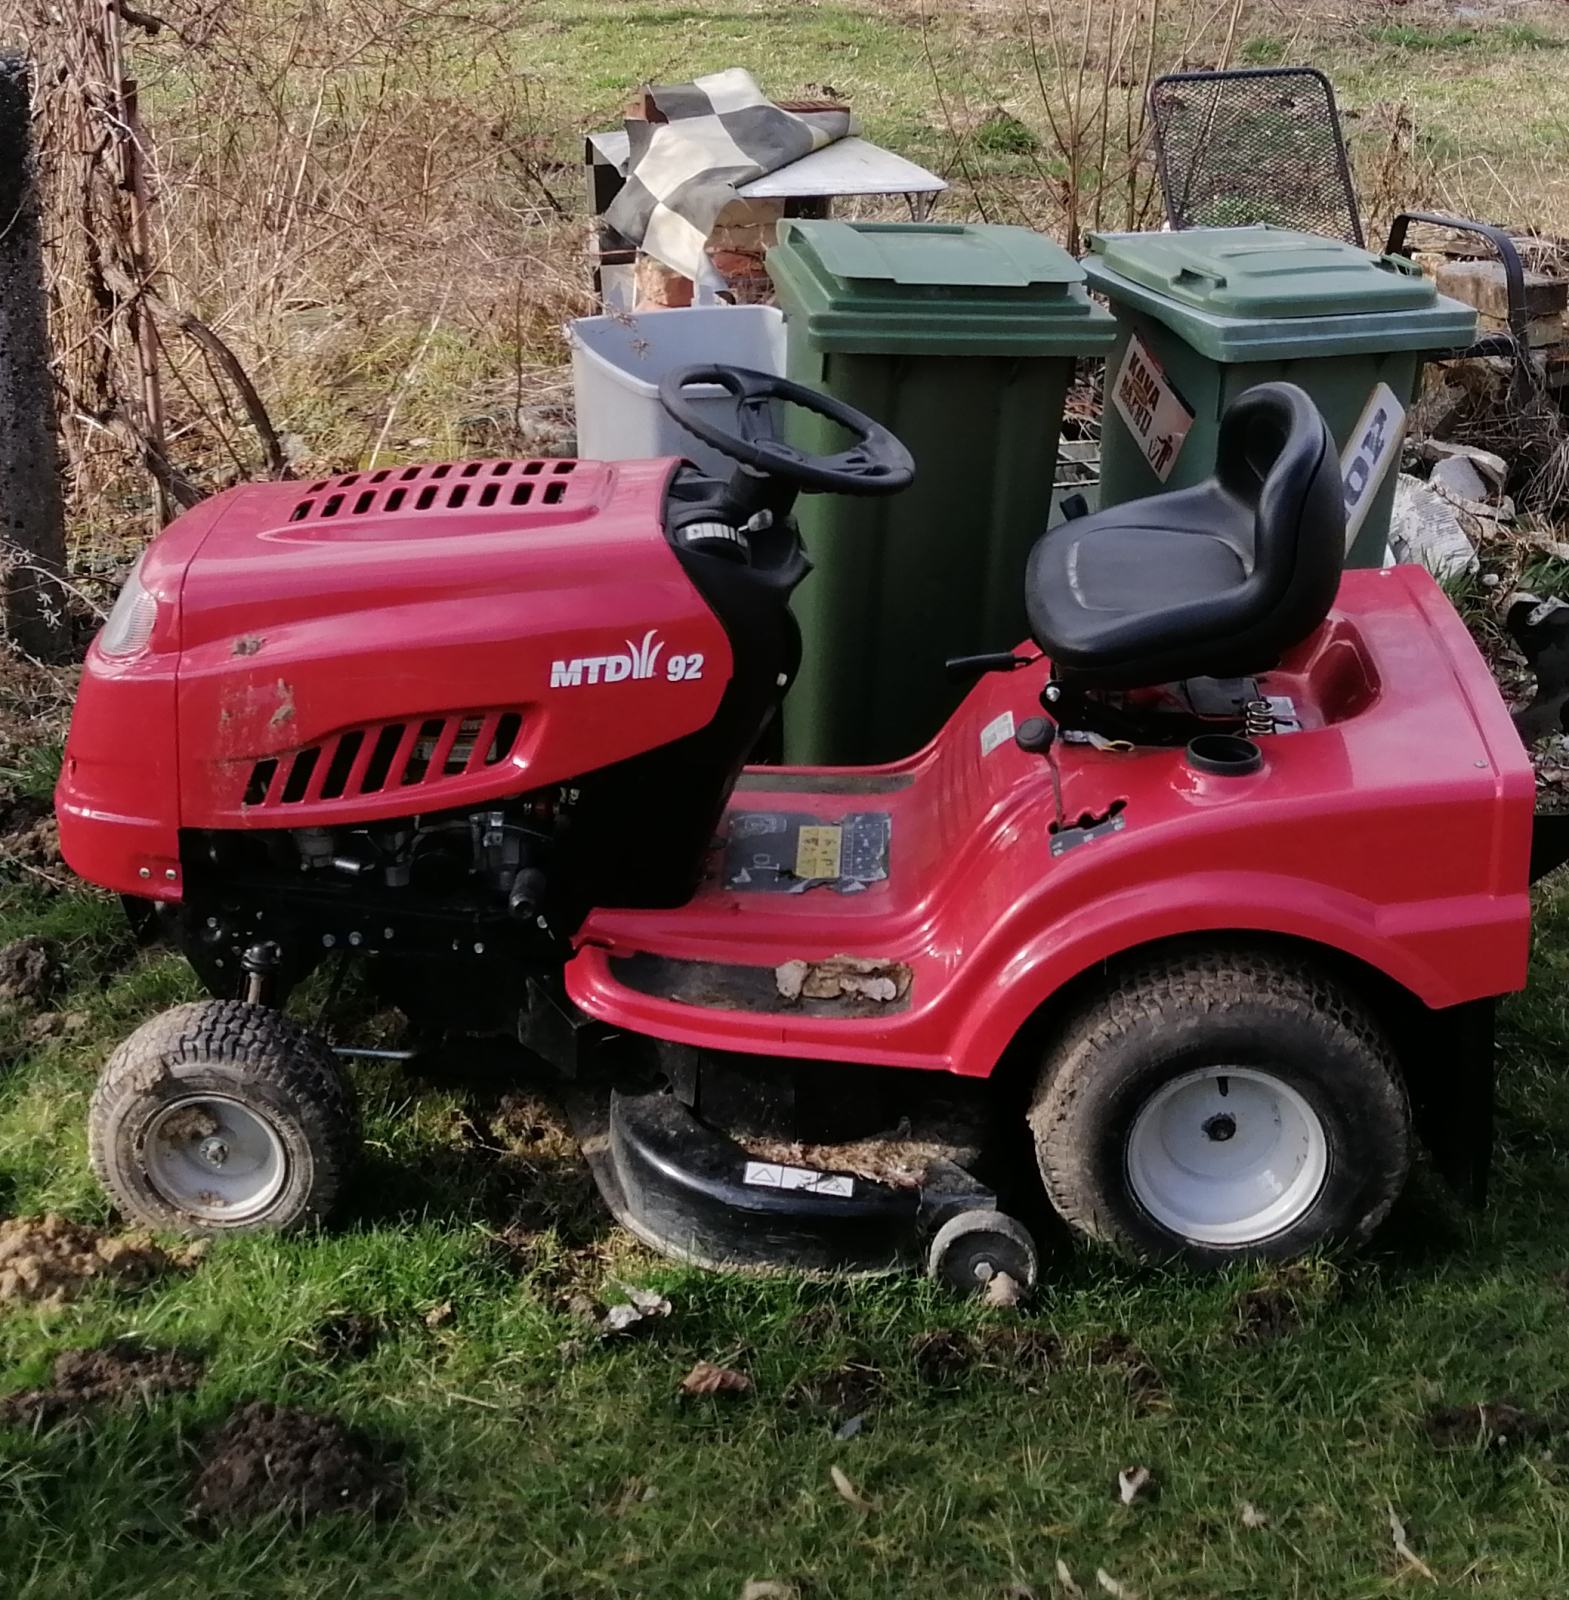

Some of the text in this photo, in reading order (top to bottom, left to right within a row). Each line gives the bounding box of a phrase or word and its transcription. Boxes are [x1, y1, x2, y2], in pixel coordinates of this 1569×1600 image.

[1128, 352, 1160, 412] KAVA
[550, 653, 704, 688] MTD 92
